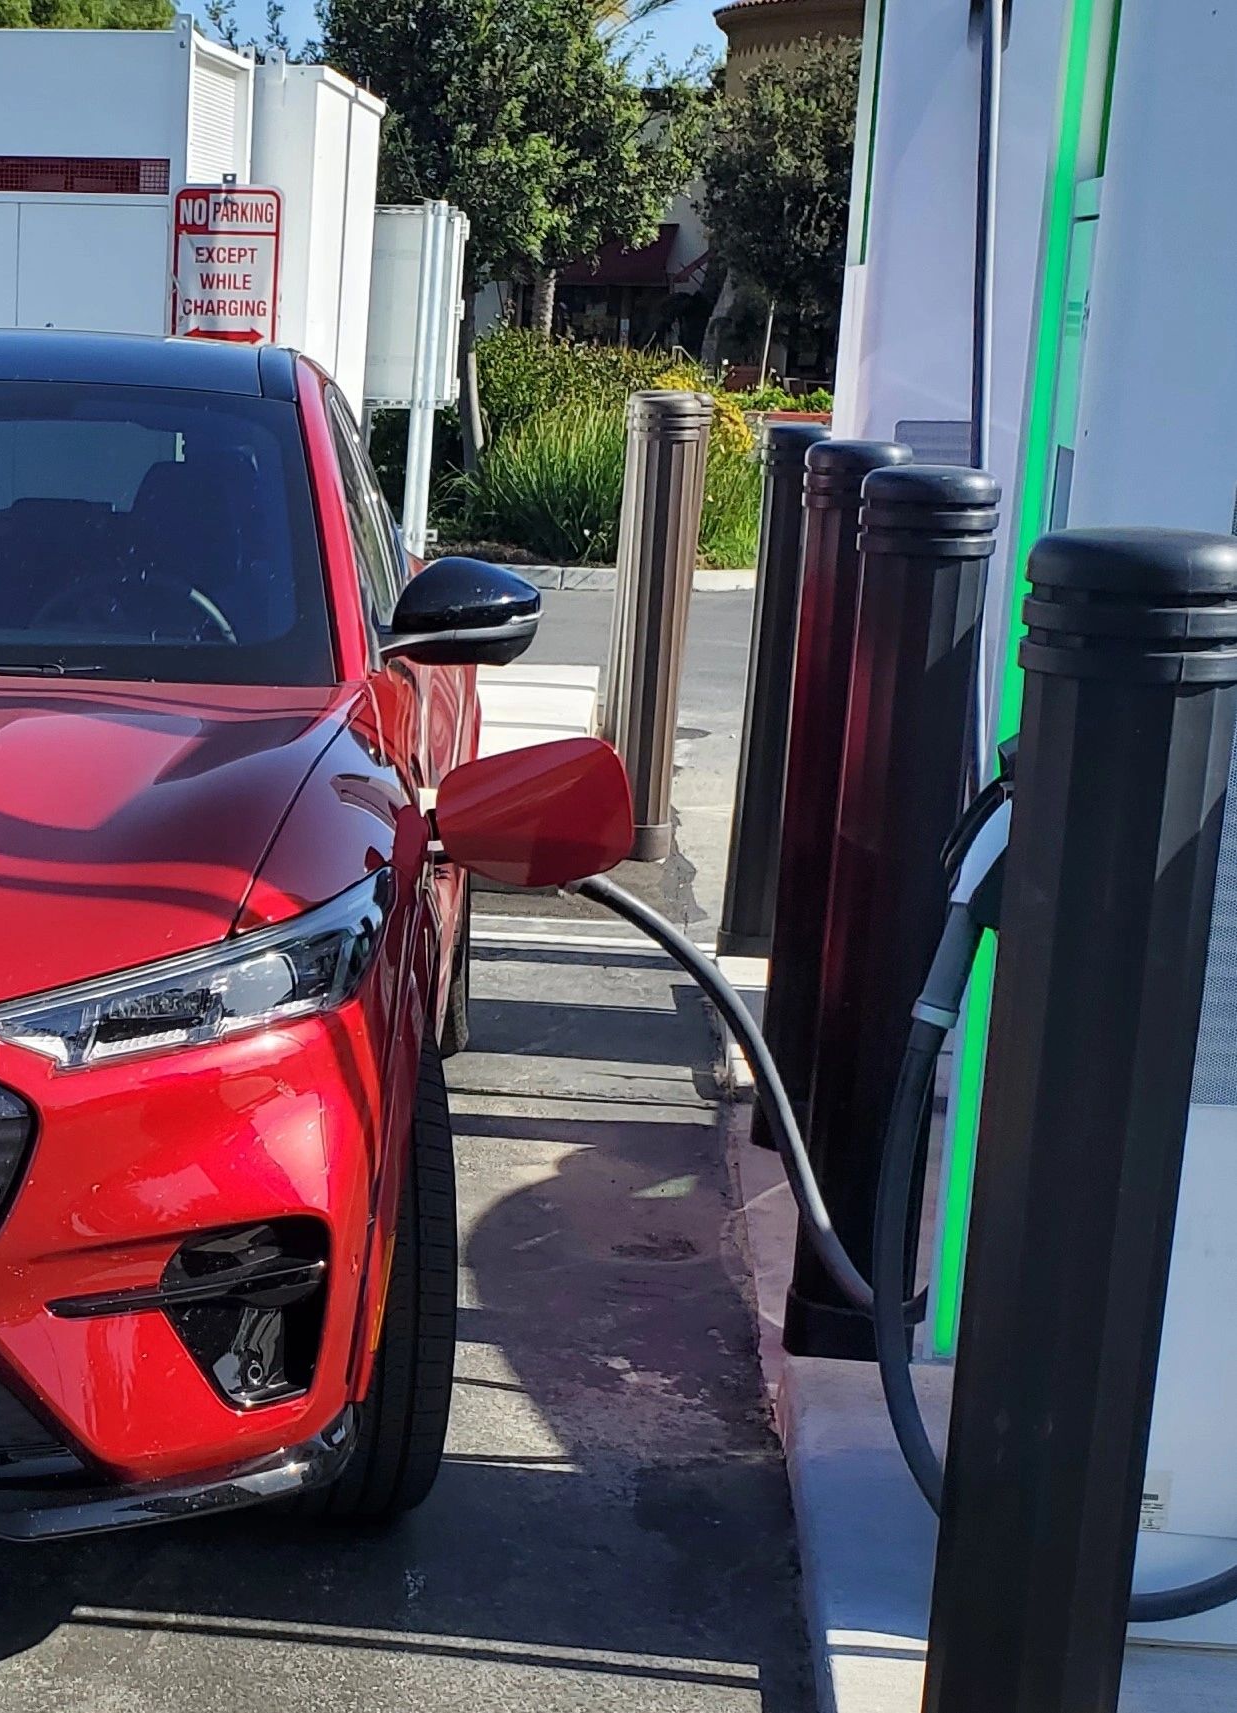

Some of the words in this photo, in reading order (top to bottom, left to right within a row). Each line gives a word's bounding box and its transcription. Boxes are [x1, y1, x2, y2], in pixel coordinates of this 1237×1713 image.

[179, 198, 207, 225] NO
[213, 201, 274, 224] PARKING
[195, 246, 258, 264] EXCEPT
[199, 273, 252, 291] WHILE
[182, 298, 267, 317] CHARGING
